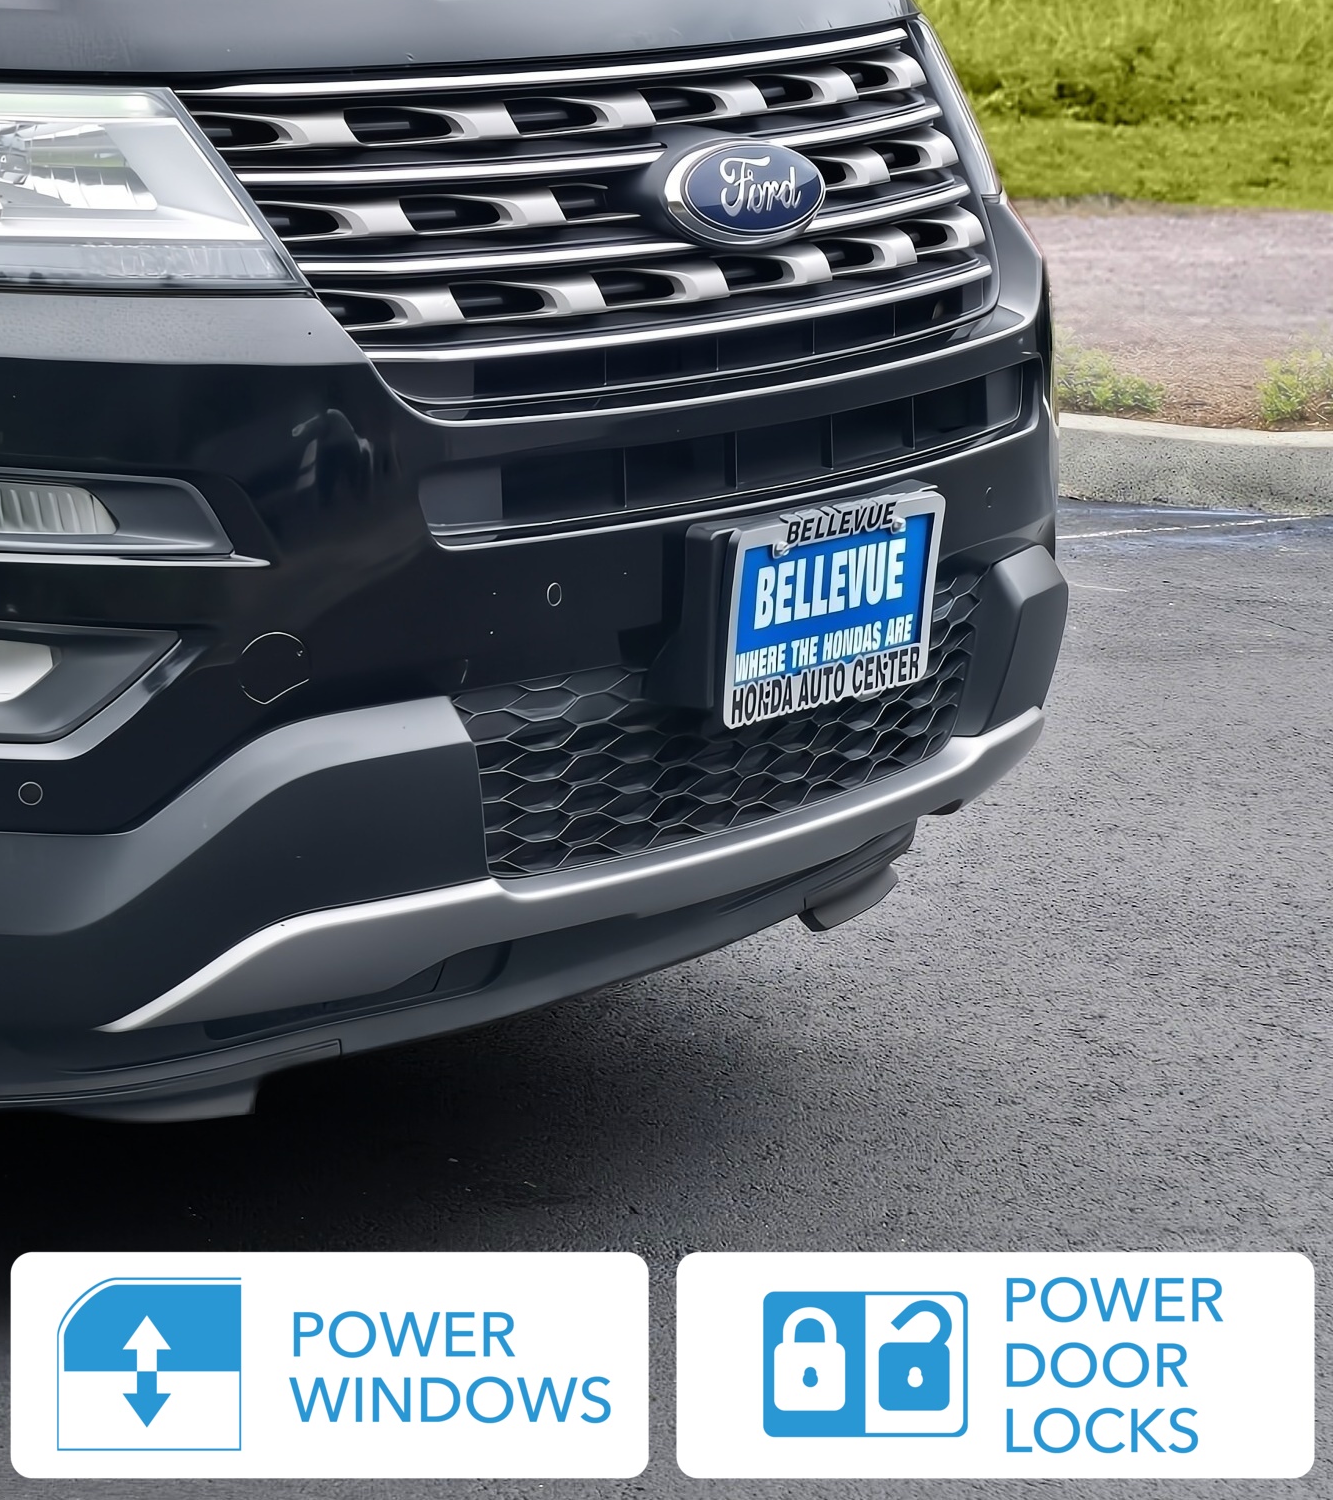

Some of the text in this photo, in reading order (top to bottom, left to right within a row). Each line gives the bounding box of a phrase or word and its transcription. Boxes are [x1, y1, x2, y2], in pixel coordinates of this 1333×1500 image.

[719, 156, 802, 217] Ford
[786, 501, 897, 545] BELLEVUE
[753, 537, 907, 630] BELLEVUE
[734, 613, 914, 683] WHERE THE HONDAS ARE
[731, 646, 921, 726] HONDA AUTO CENTER
